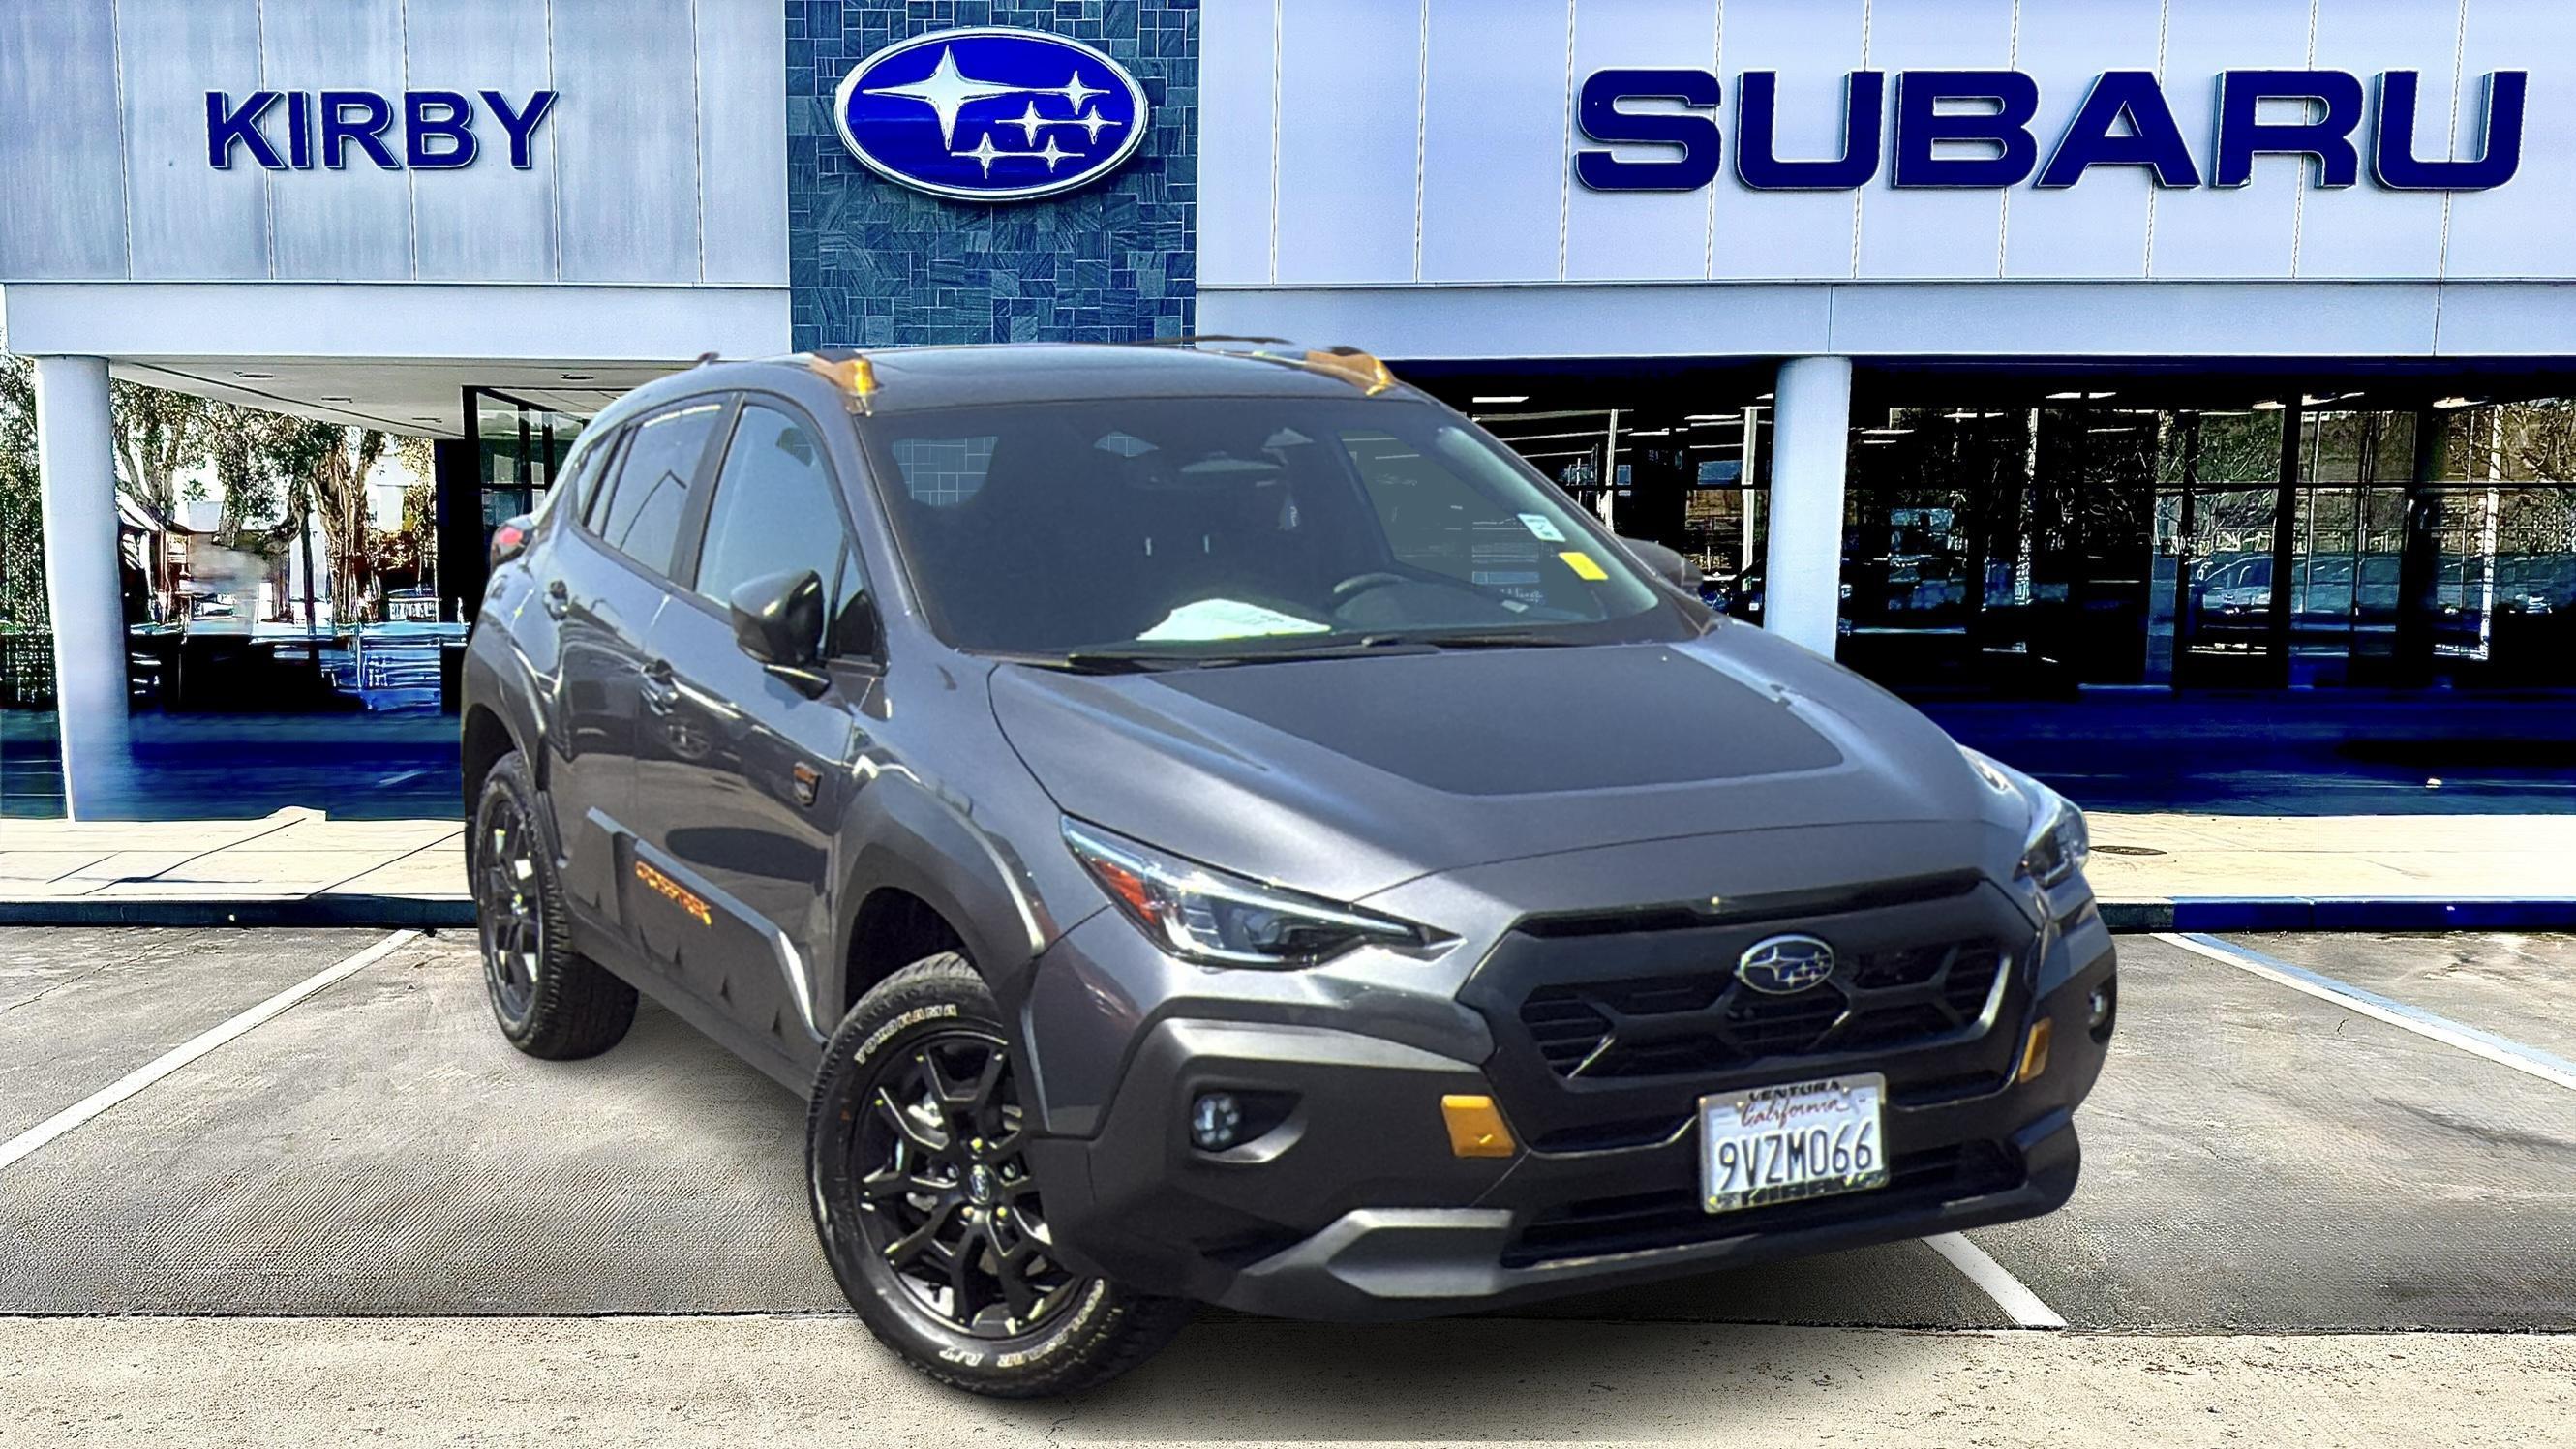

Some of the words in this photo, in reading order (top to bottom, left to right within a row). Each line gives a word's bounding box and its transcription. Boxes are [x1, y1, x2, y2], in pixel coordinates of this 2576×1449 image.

[204, 90, 558, 169] KIRBY
[1574, 69, 2526, 190] SUBARU
[853, 1003, 958, 1065] YOKOHAMA
[1741, 1097, 1850, 1128] California
[1748, 1080, 1840, 1102] VENTURA
[1718, 1121, 1874, 1192] 9VZM066
